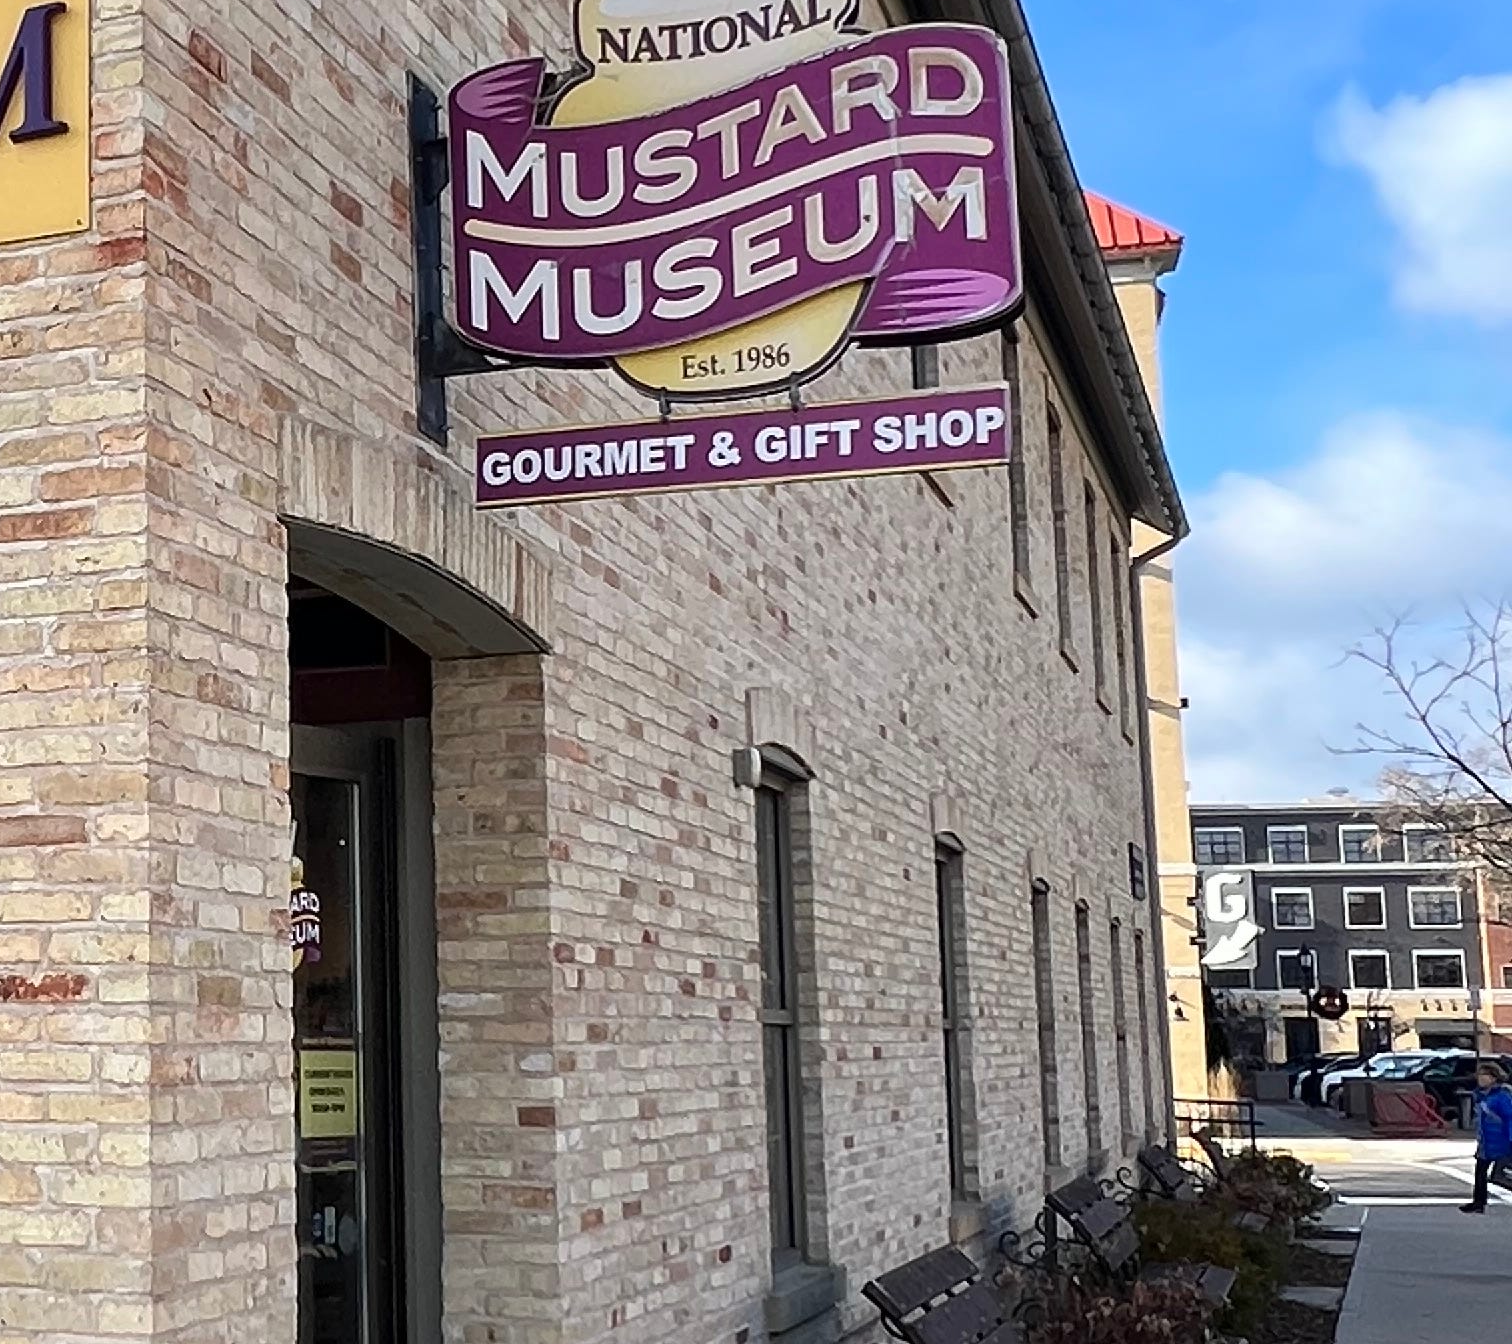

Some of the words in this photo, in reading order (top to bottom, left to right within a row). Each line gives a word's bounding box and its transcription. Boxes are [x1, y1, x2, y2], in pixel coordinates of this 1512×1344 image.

[465, 46, 985, 219] MUSTARD
[468, 165, 985, 342] MUSEUM
[680, 353, 727, 380] Est.
[734, 343, 791, 376] 1986
[481, 435, 696, 486] GOURMET
[708, 433, 740, 468] &
[754, 419, 860, 464] GIFT
[872, 406, 1007, 452] SHOP
